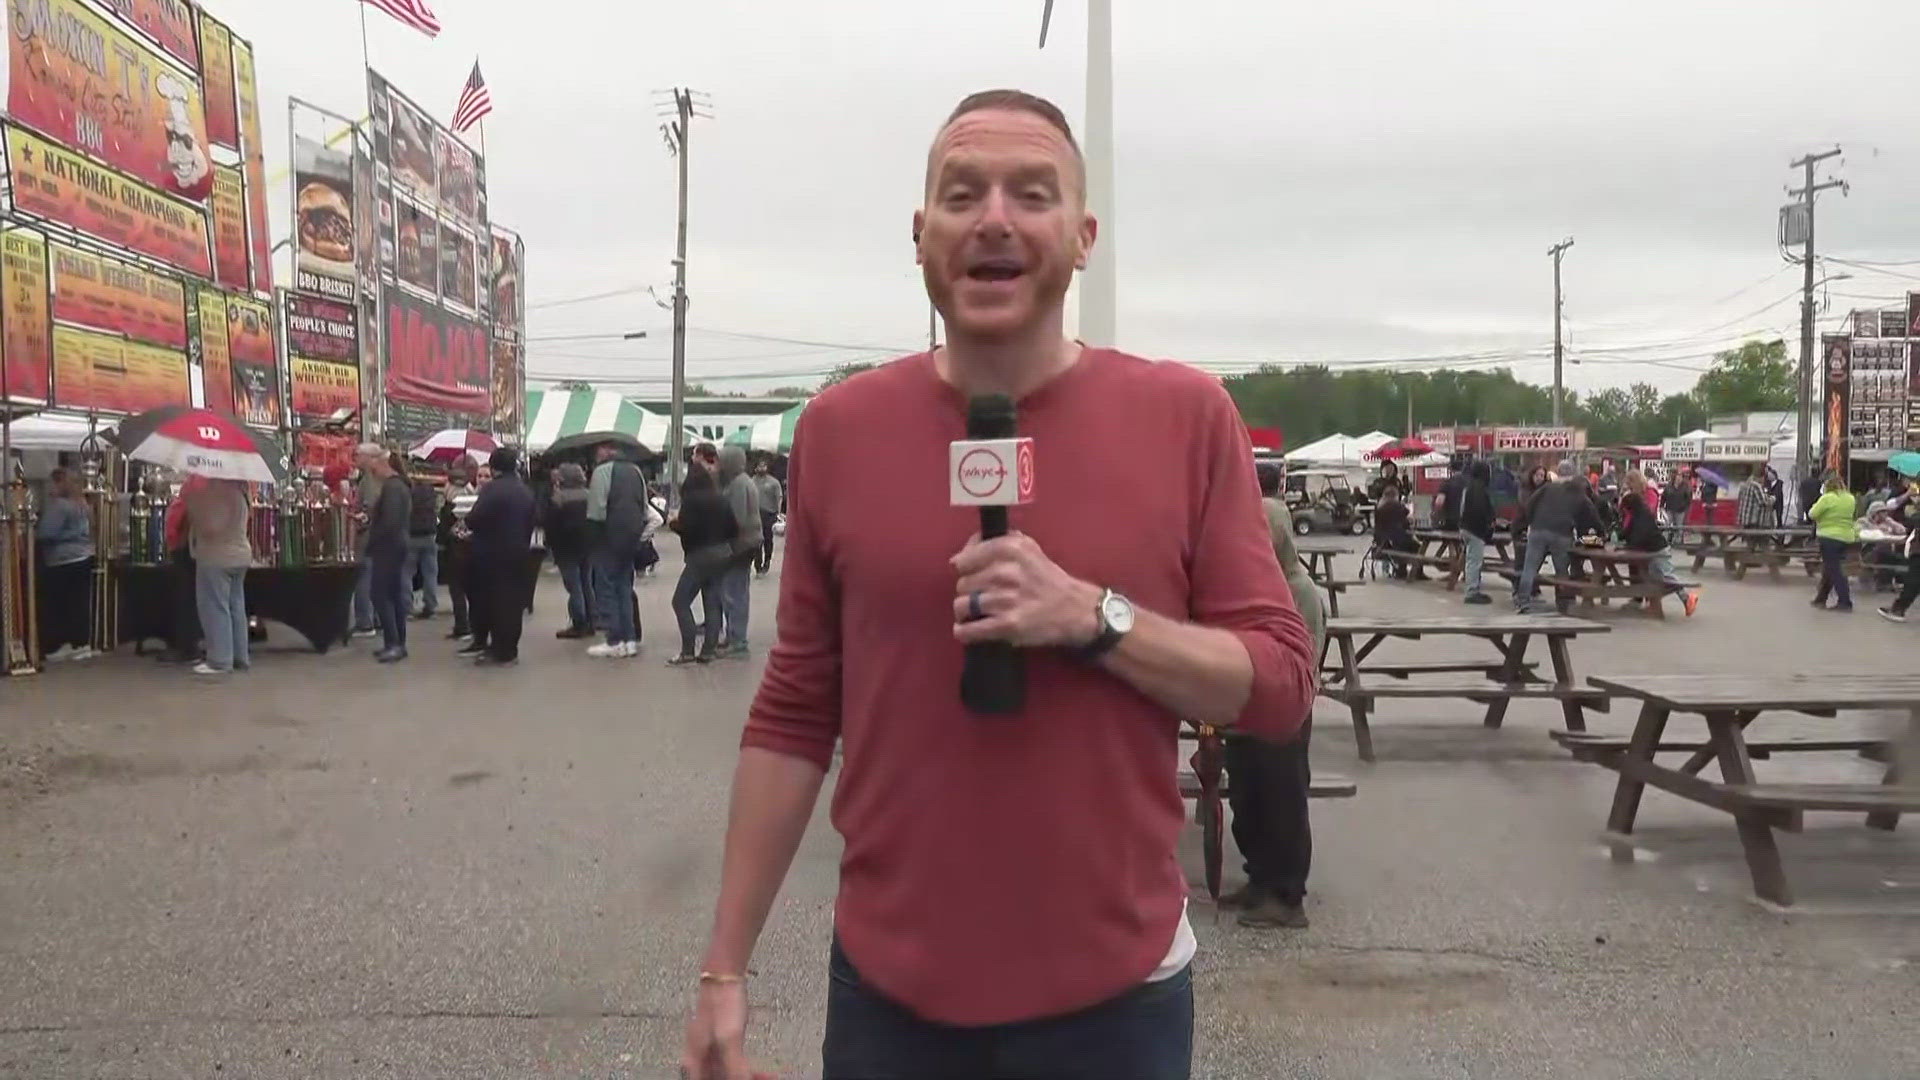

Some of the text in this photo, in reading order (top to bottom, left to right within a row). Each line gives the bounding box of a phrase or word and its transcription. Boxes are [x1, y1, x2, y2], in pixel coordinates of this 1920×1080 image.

[44, 150, 117, 201] NATIONAL
[121, 183, 186, 227] CHAMPIONS
[320, 276, 353, 299] BRISKET
[290, 315, 355, 339] PEOPLE'S CHOICE
[1499, 438, 1569, 449] PIEROGI
